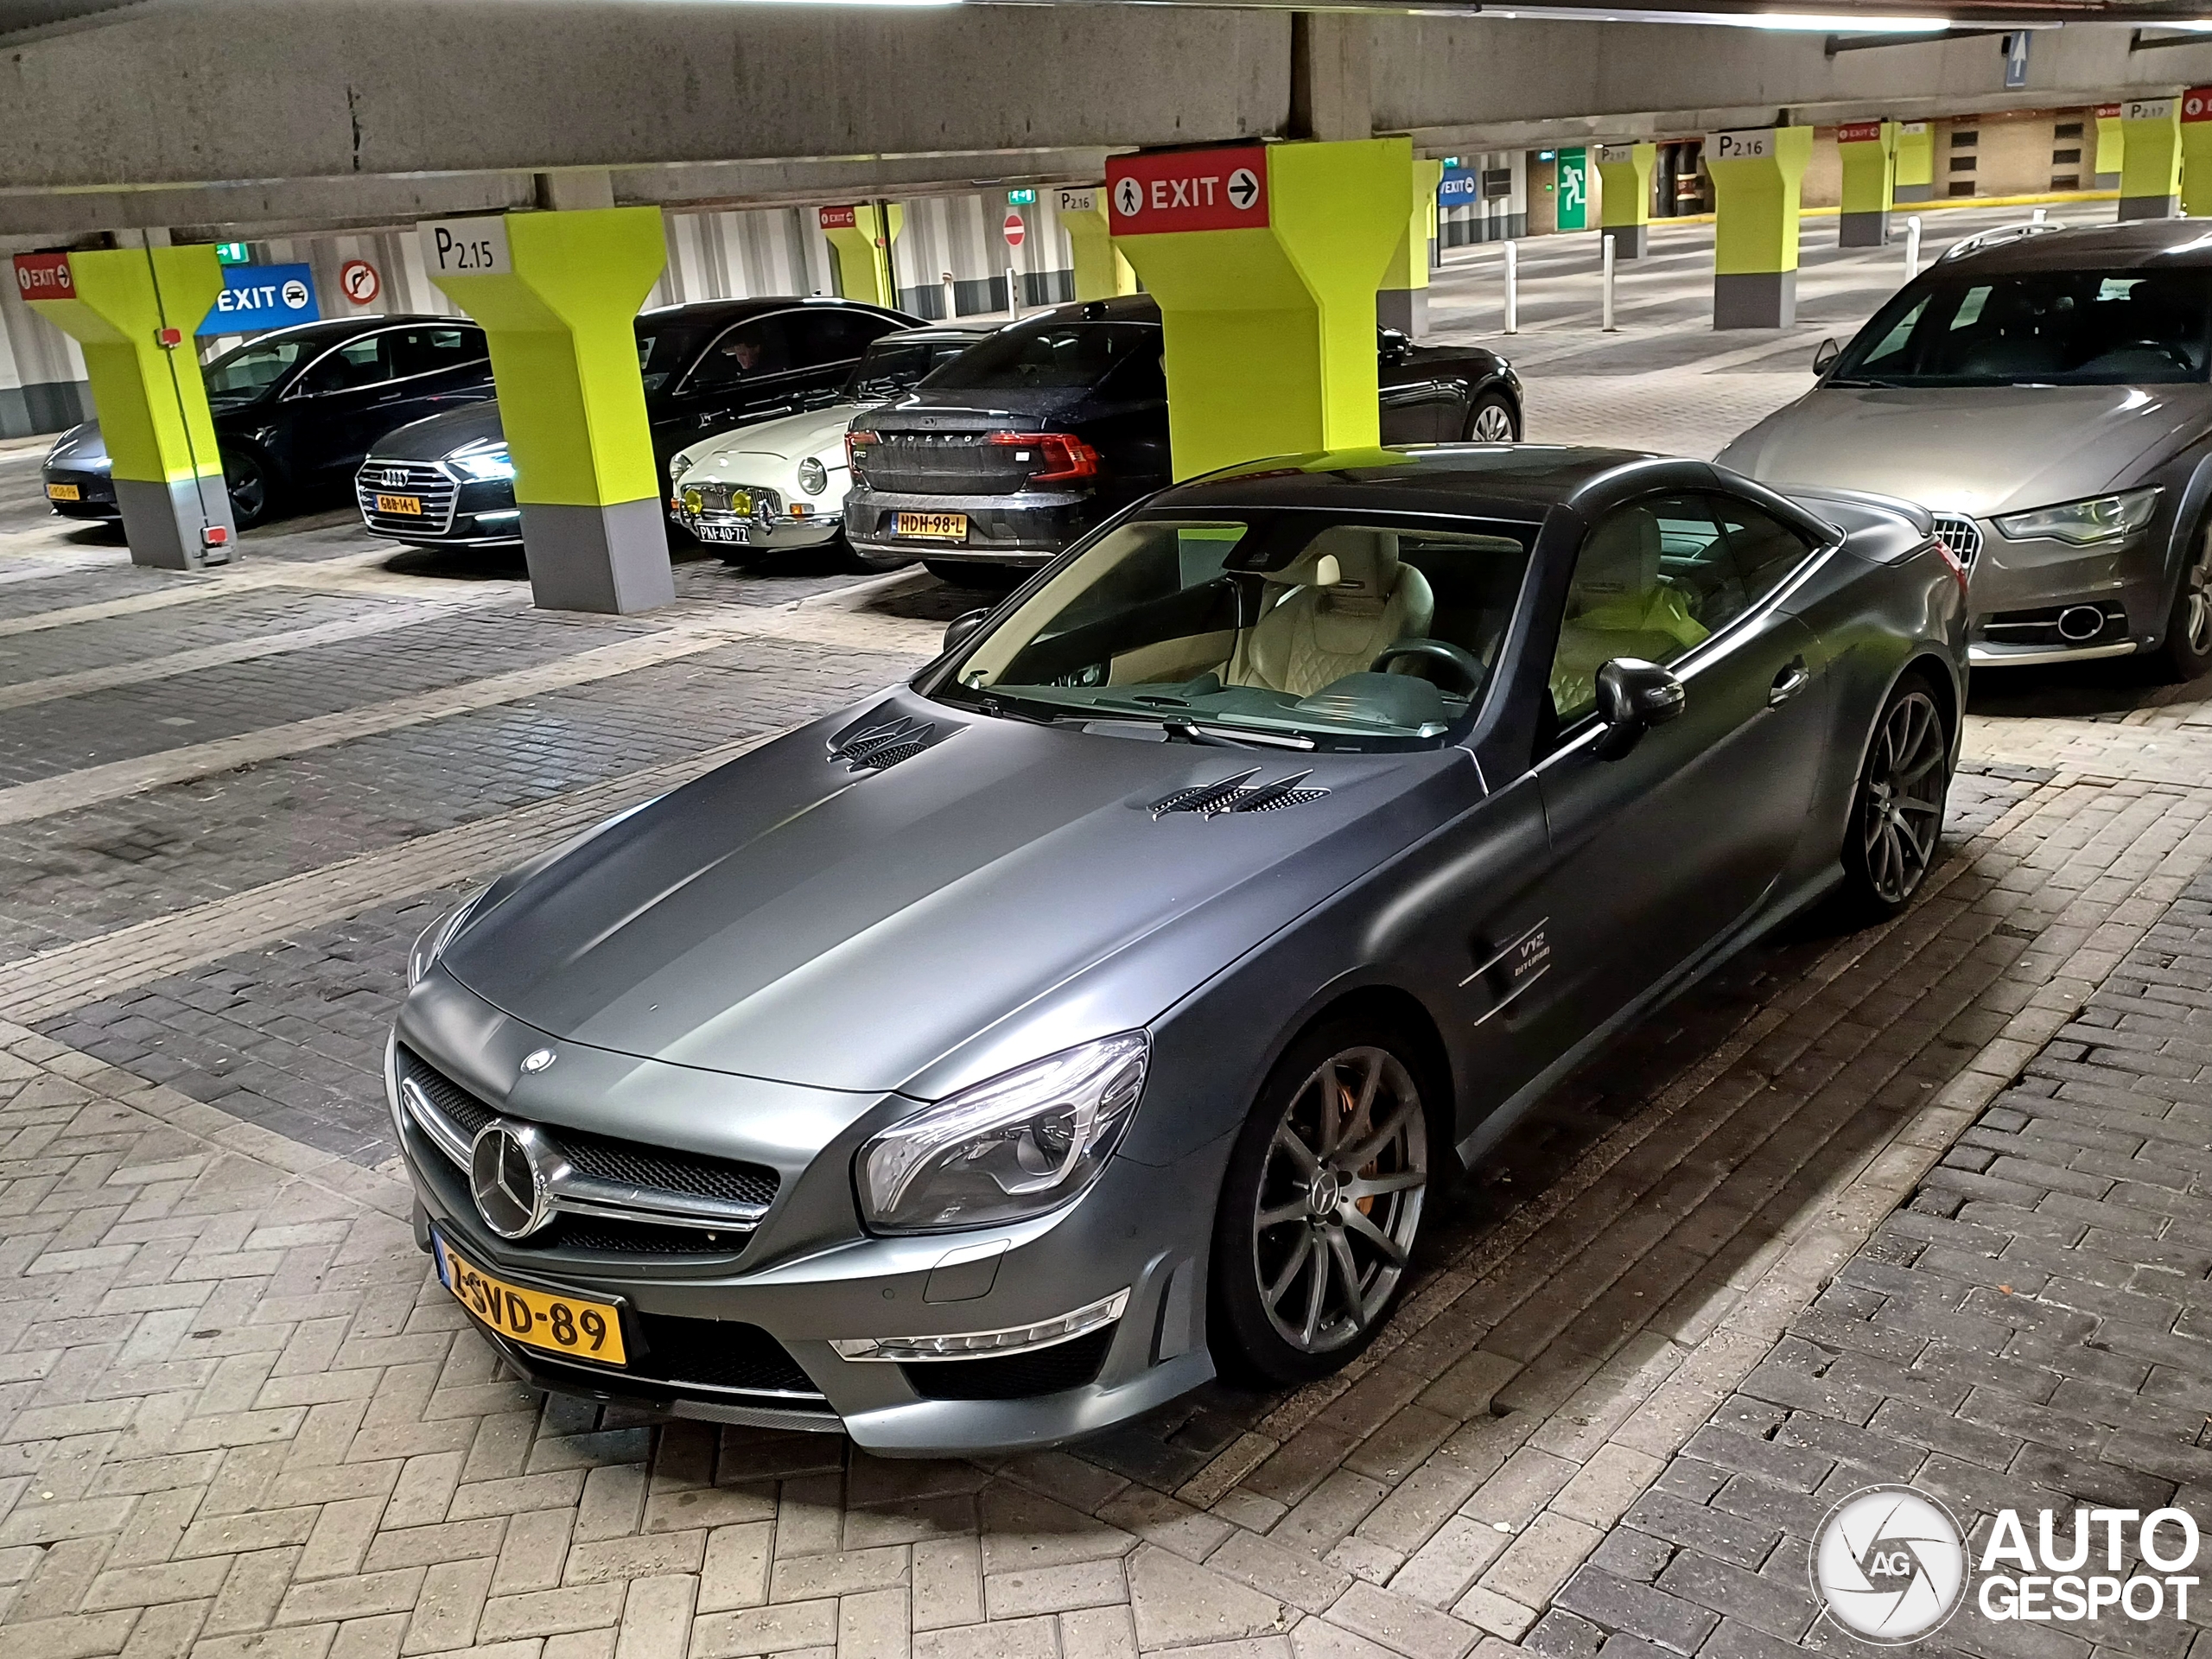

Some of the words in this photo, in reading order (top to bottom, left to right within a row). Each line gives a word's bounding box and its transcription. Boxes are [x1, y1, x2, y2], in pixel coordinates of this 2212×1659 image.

[1151, 176, 1219, 209] EXIT
[434, 227, 493, 270] P2.15
[30, 268, 56, 287] EXIT
[217, 285, 276, 312] EXIT
[900, 515, 963, 534] HDH-98-L
[1521, 931, 1545, 958] V12
[447, 1253, 607, 1352] 2-SVD-89
